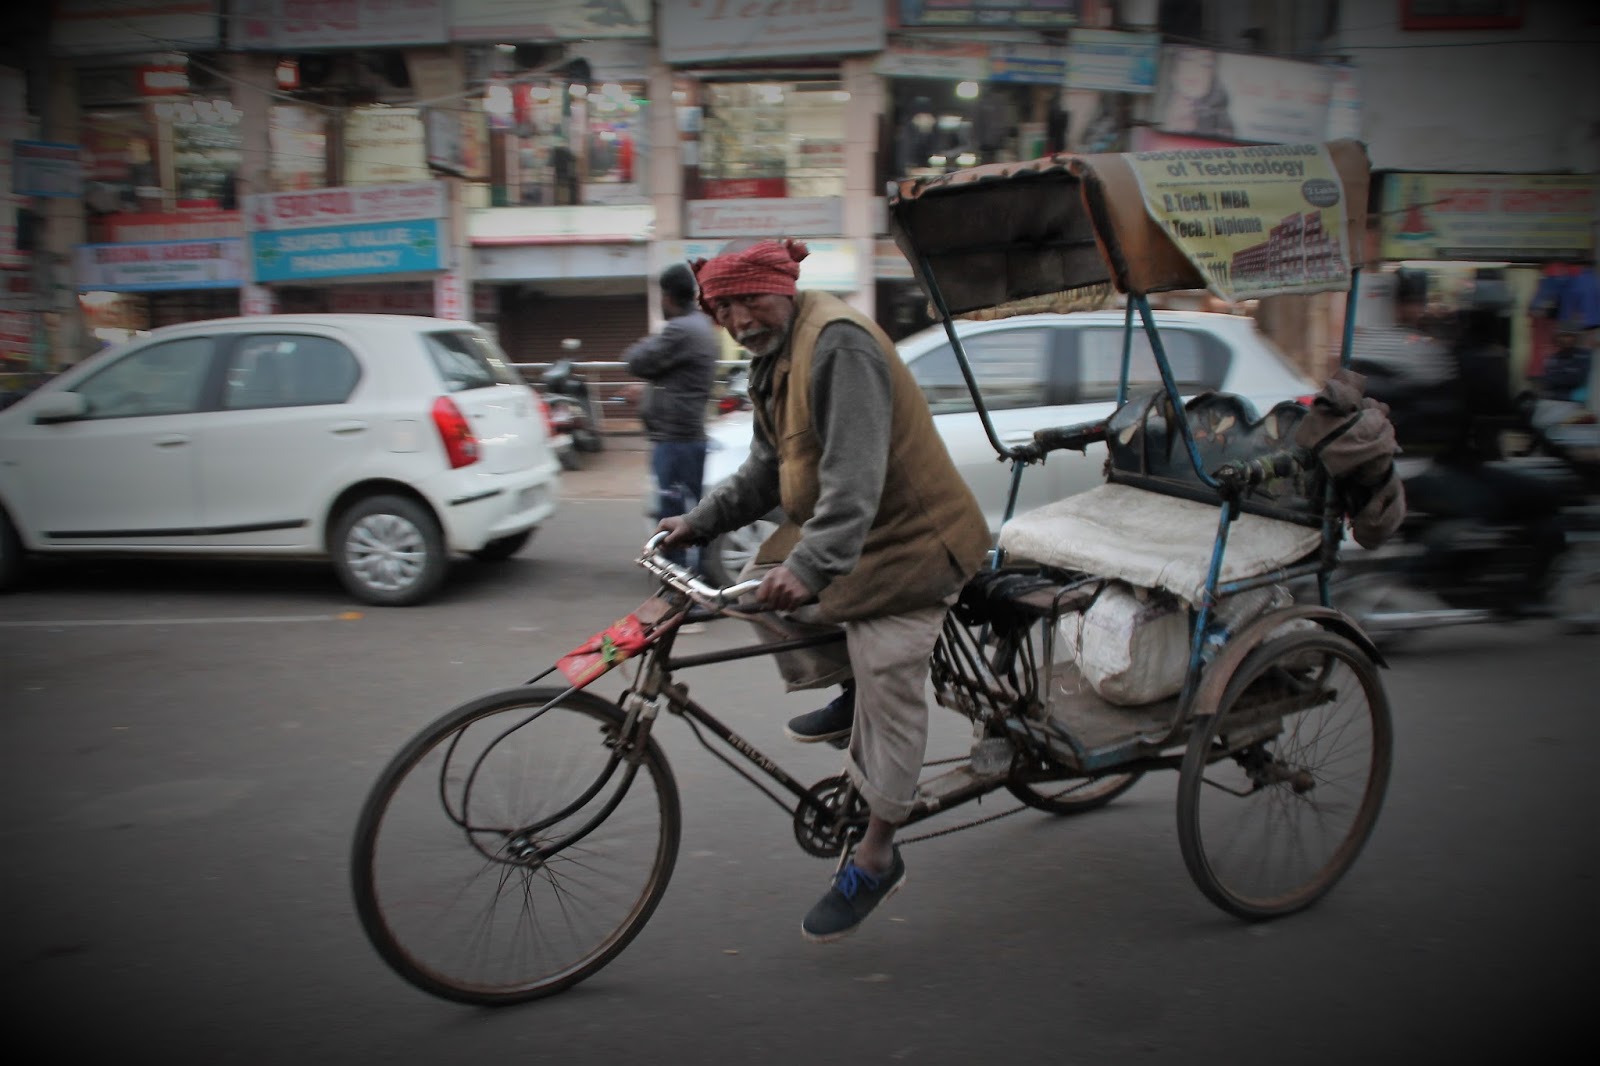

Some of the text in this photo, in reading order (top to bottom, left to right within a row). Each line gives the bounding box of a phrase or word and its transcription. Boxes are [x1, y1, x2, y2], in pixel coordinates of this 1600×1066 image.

[1167, 159, 1305, 177] of Technology
[1221, 190, 1250, 209] MBA
[1214, 216, 1263, 236] Diploma
